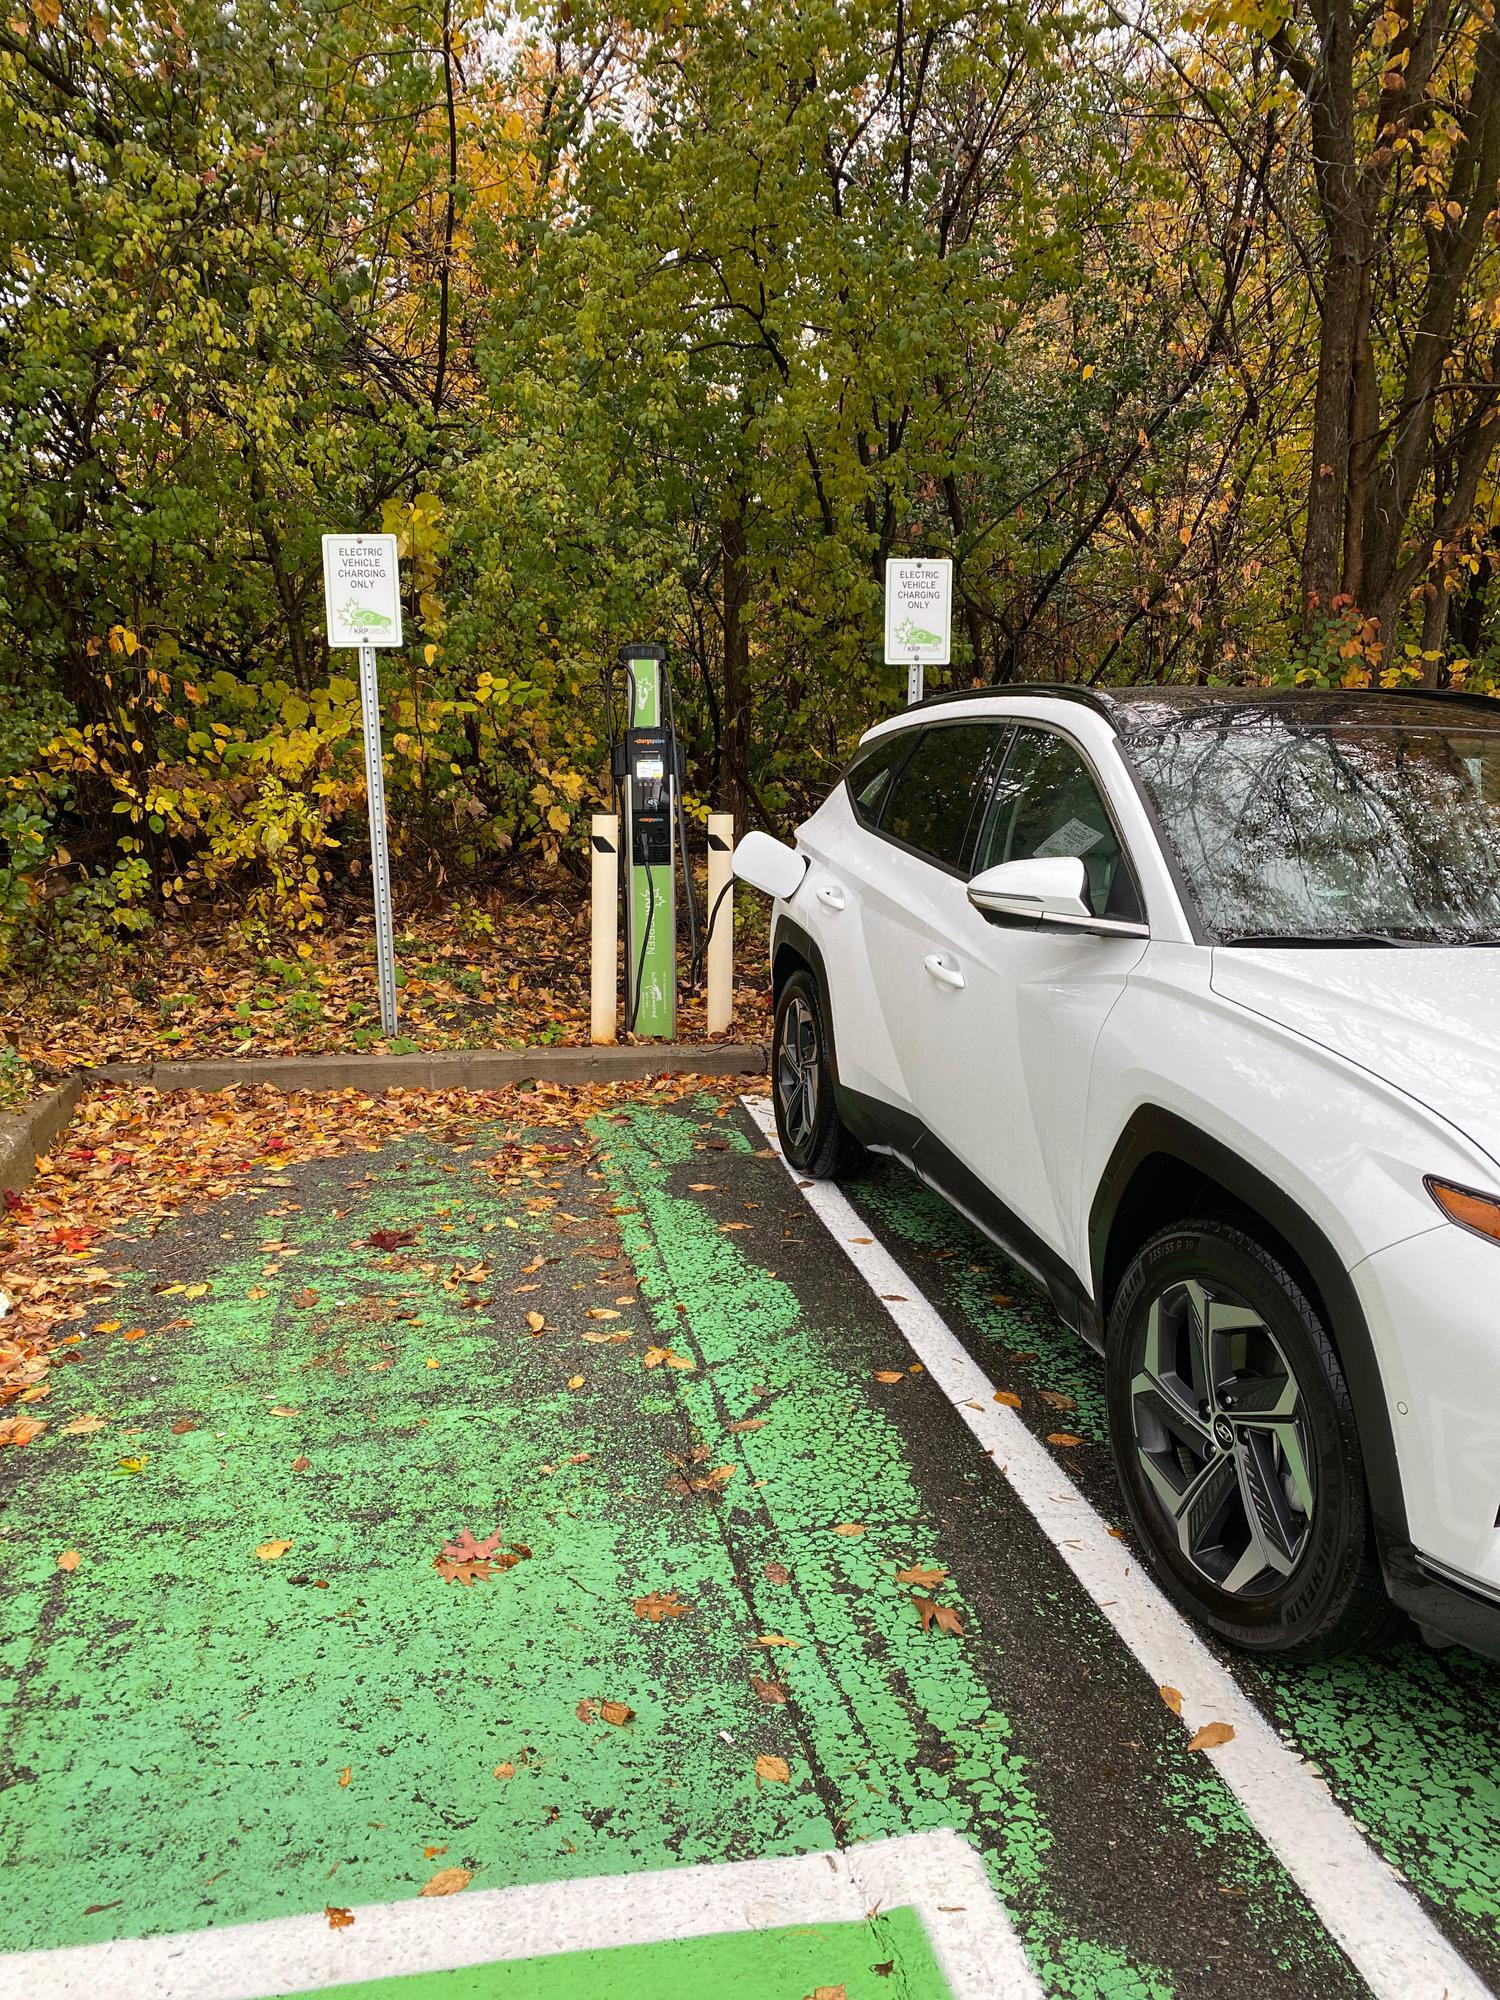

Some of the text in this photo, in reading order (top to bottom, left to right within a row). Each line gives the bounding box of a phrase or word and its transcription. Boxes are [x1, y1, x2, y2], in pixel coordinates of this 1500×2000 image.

[339, 548, 383, 556] ELECTRIC
[342, 559, 380, 567] VEHICLE
[338, 570, 385, 578] CHARGING
[350, 580, 375, 589] ONLY
[902, 581, 936, 589] VEHICLE
[898, 591, 940, 599] CHARGING
[907, 601, 930, 609] ONLY
[1148, 1239, 1194, 1265] 235/55 R 19
